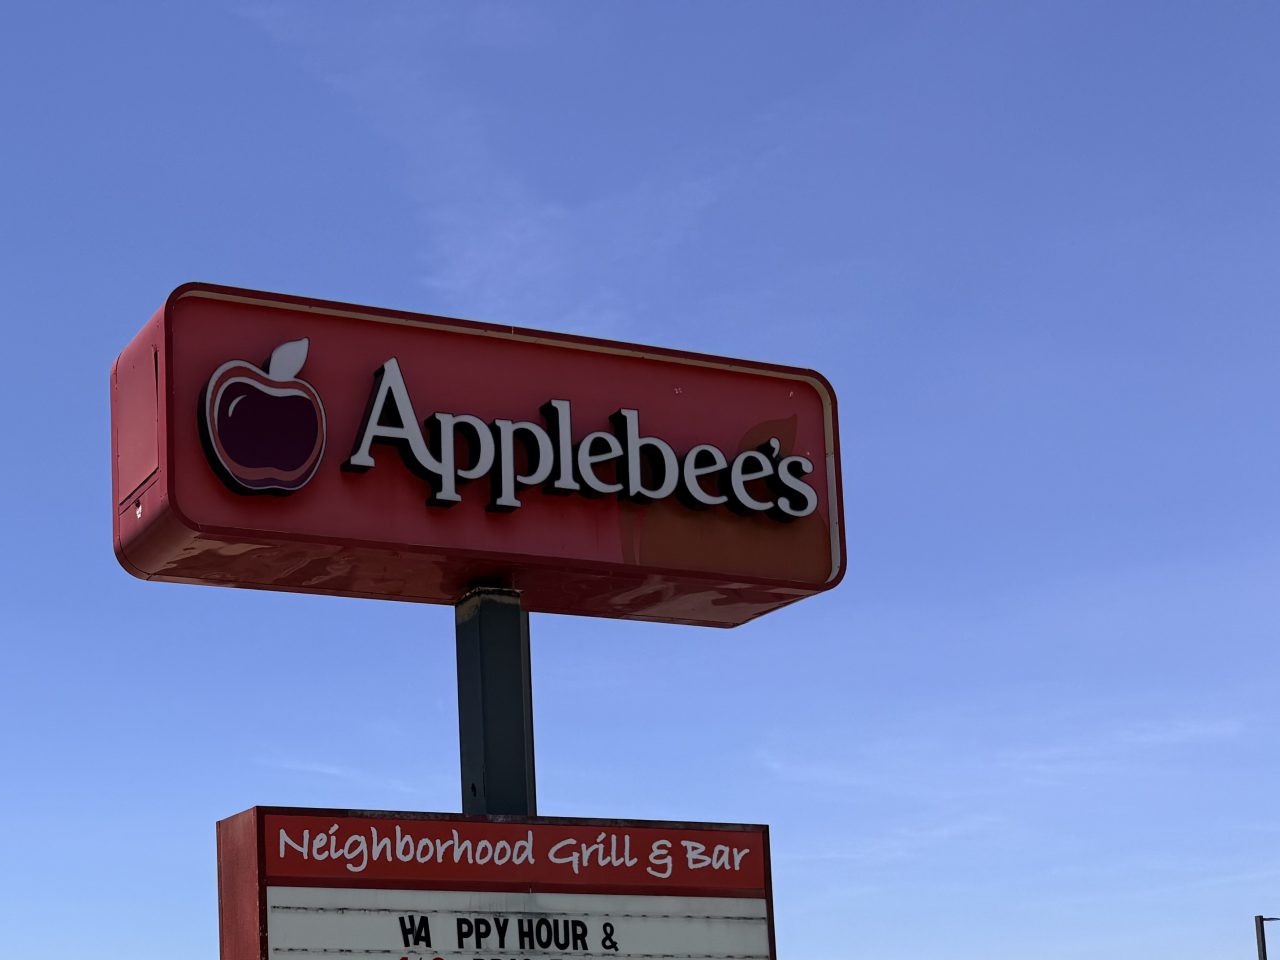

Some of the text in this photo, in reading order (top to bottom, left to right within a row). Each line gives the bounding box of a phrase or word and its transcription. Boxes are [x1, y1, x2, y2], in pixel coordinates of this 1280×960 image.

[350, 356, 819, 518] Applebee's
[278, 823, 750, 879] Neighborhood Grill & Bar
[517, 918, 589, 951] HOUR
[601, 921, 620, 952] &
